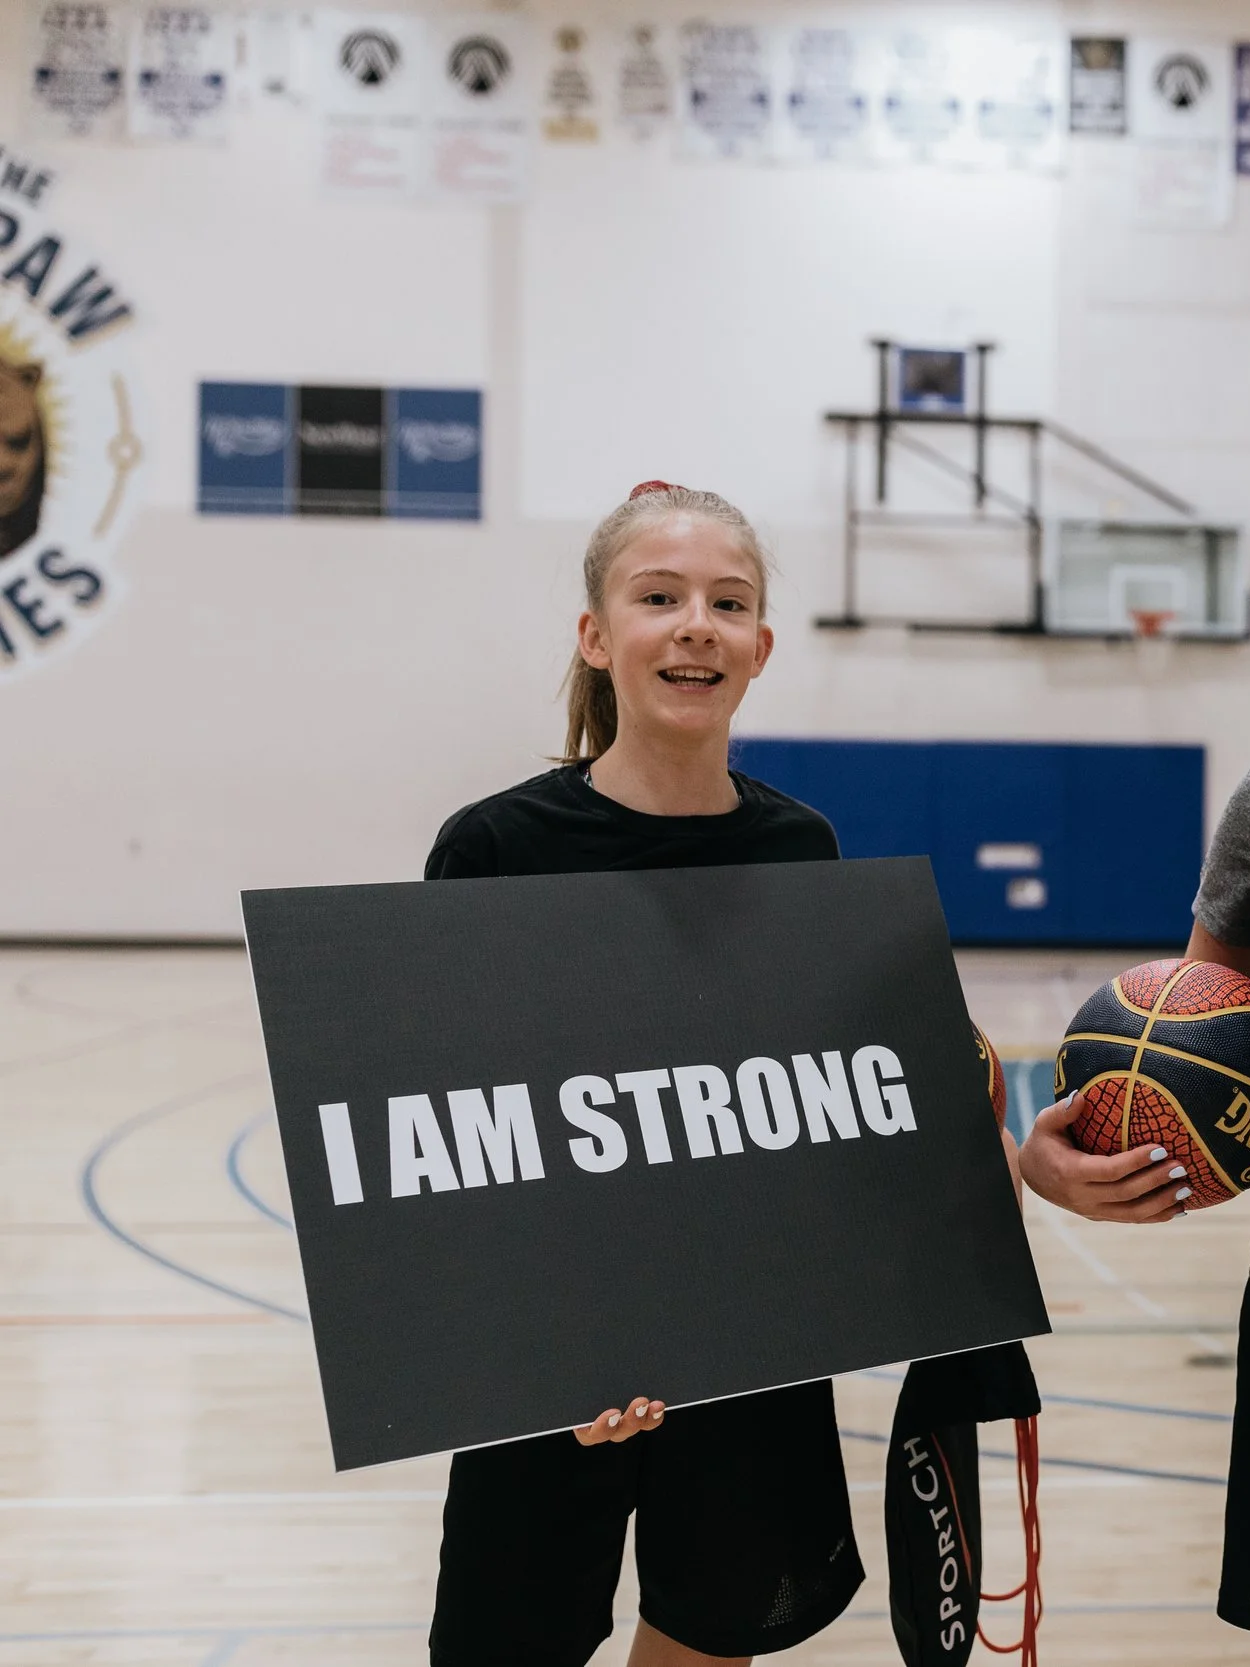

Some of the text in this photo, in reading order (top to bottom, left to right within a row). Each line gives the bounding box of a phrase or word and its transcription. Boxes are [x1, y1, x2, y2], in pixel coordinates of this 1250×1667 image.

[0, 146, 49, 203] HE
[319, 1046, 917, 1205] I AM STRONG
